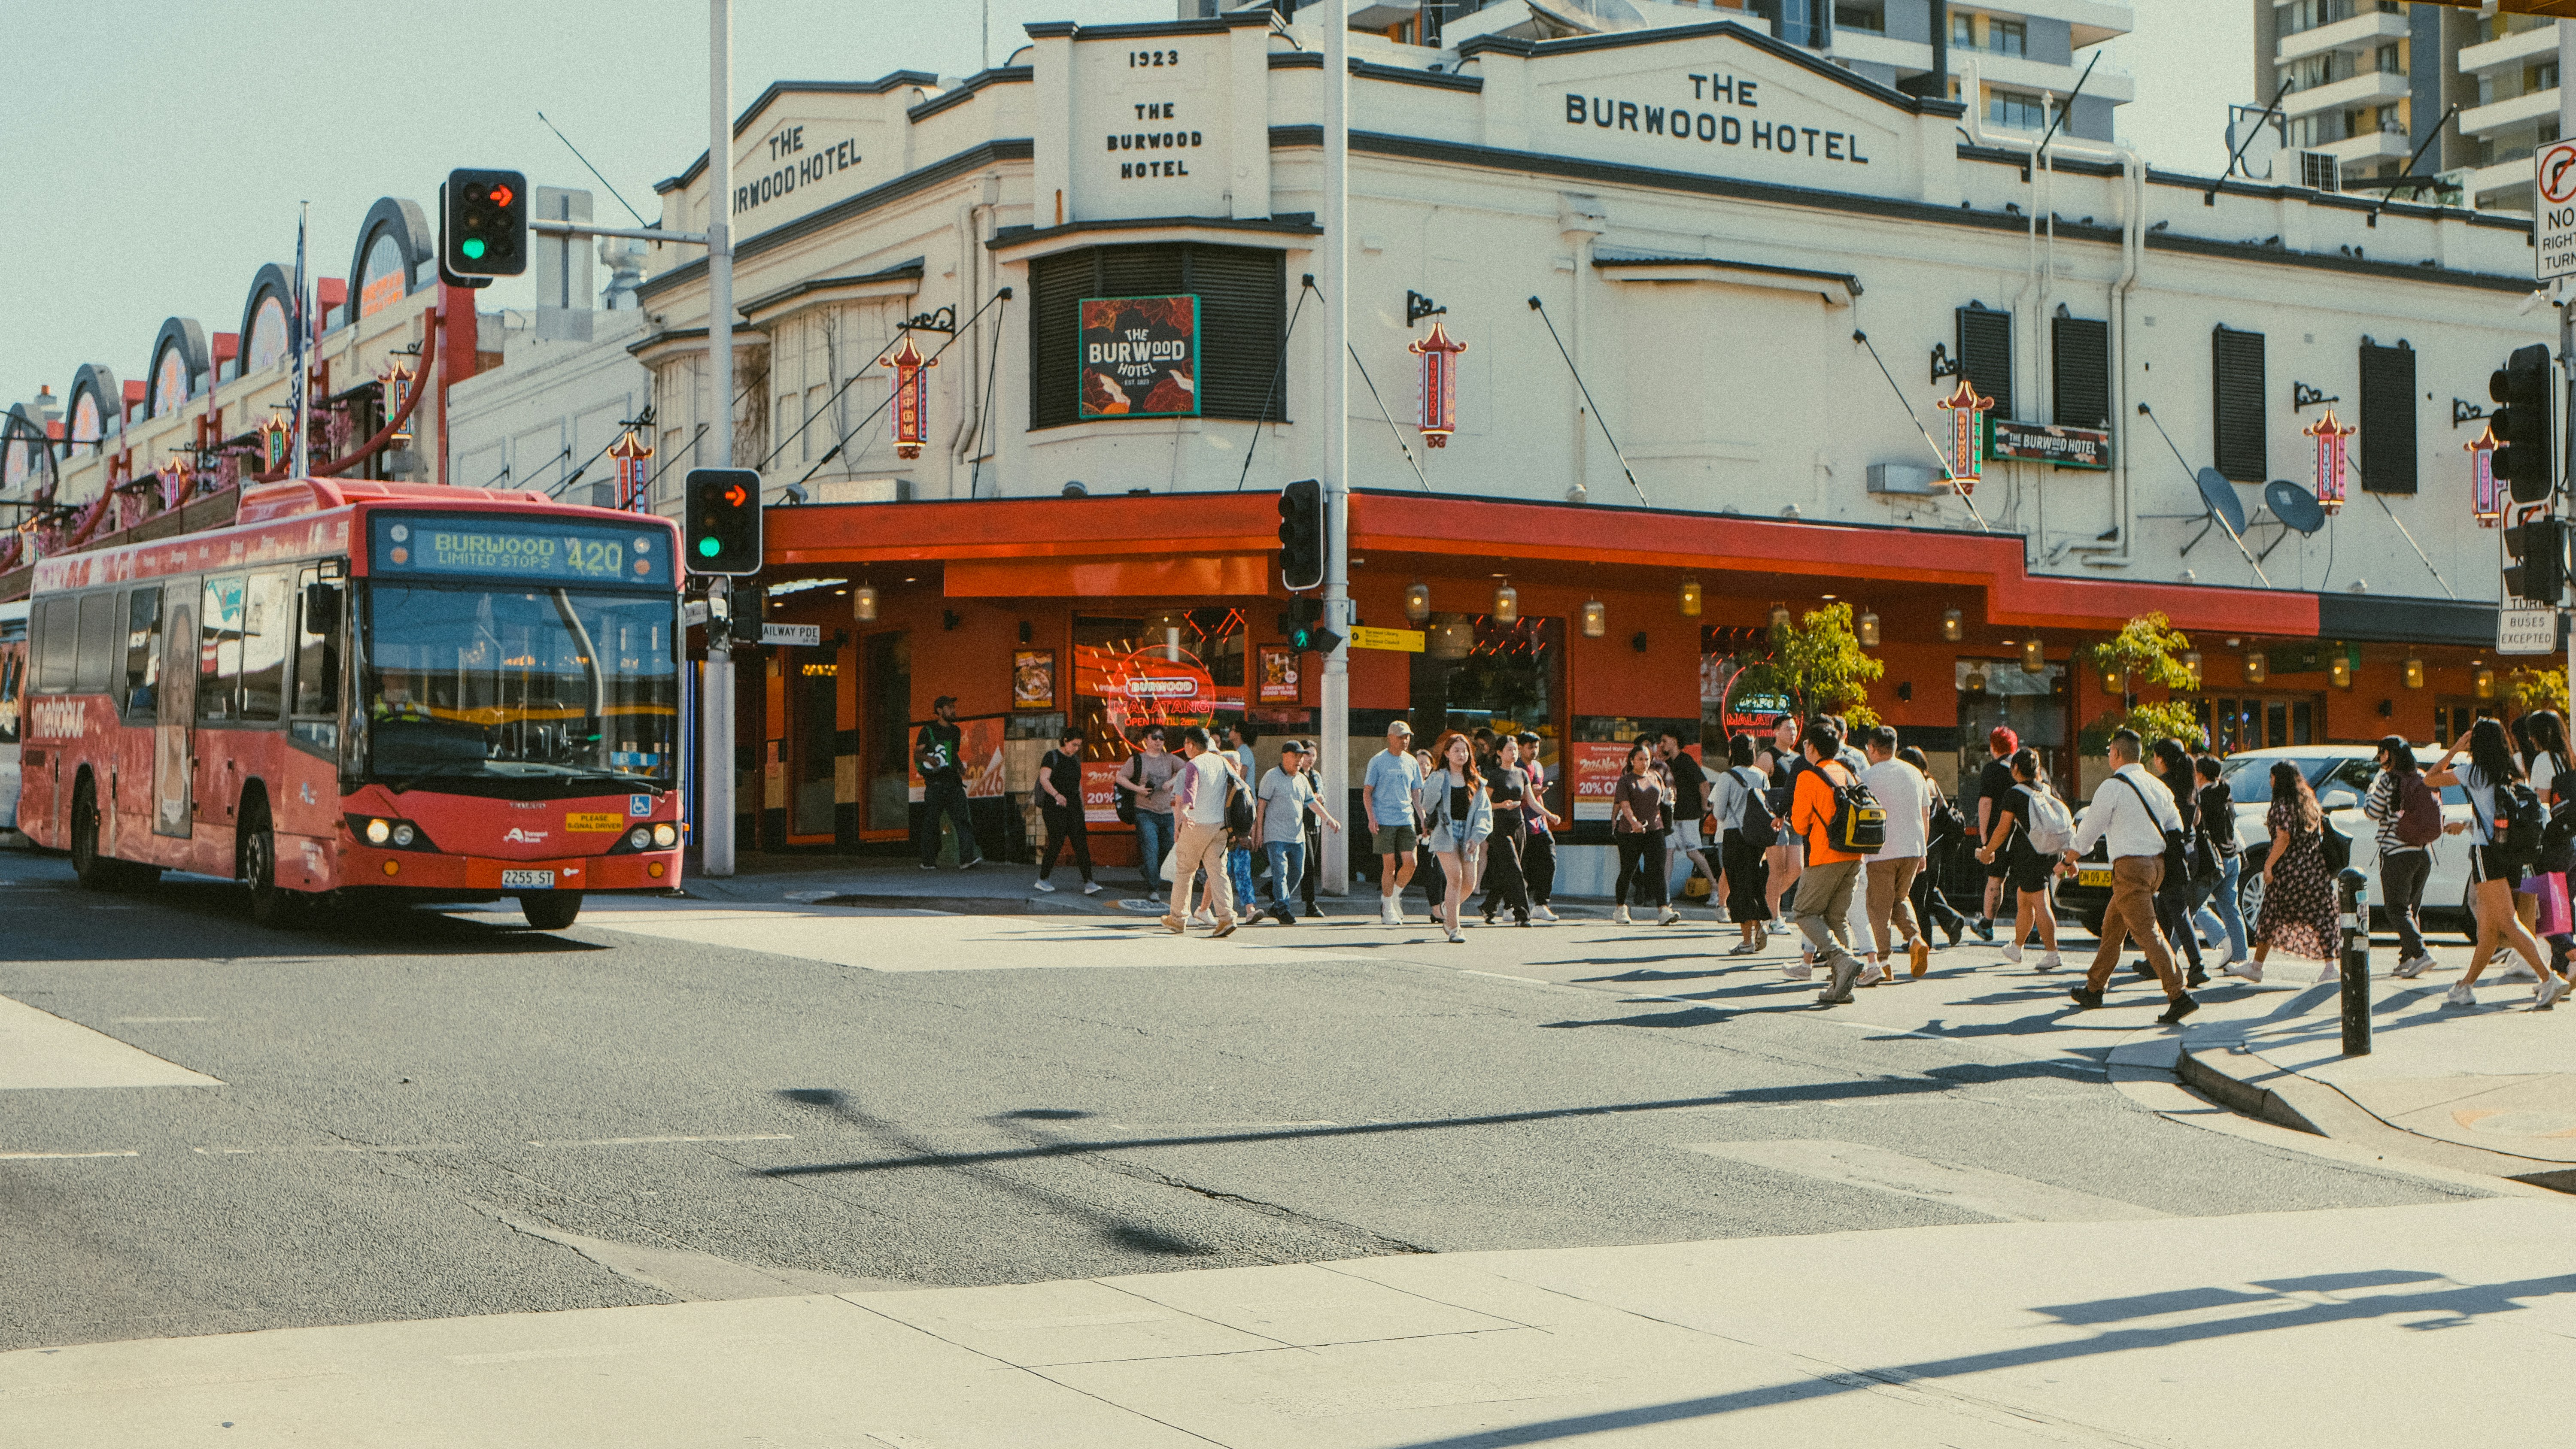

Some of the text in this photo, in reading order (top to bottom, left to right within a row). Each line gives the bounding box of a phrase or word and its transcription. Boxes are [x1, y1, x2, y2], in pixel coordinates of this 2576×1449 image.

[1130, 50, 1178, 67] 1923
[1689, 73, 1758, 107] THE
[1135, 102, 1174, 120] THE
[1567, 94, 1868, 164] BURWOOD HOTEL
[769, 125, 803, 161] THE
[1107, 131, 1201, 152] BURWOOD
[732, 137, 861, 216] RWOOD HOTEL
[1121, 160, 1188, 179] HOTEL
[2549, 207, 2574, 230] NO
[1125, 328, 1149, 341] THE
[1089, 340, 1185, 364] BURWOOD
[1117, 363, 1157, 377] HOTEL
[1429, 361, 1438, 416] BURWOOD
[2009, 433, 2096, 455] THE BURWOOD HOTEL
[435, 534, 622, 576] BURWOOD 420
[439, 551, 550, 568] LIMITED STOPS
[2511, 598, 2541, 609] TUR
[2510, 617, 2545, 627] BUSES
[763, 625, 817, 638] AILWAY PDE
[2501, 634, 2551, 644] EXCEPTED
[1131, 681, 1193, 693] BURWOOD
[1113, 700, 1210, 713] MALATANG
[1124, 717, 1198, 726] OPEN UNTIL 2am
[1579, 782, 1602, 794] 20%
[1087, 792, 1115, 804] 20%
[504, 871, 553, 884] 2255 ST
